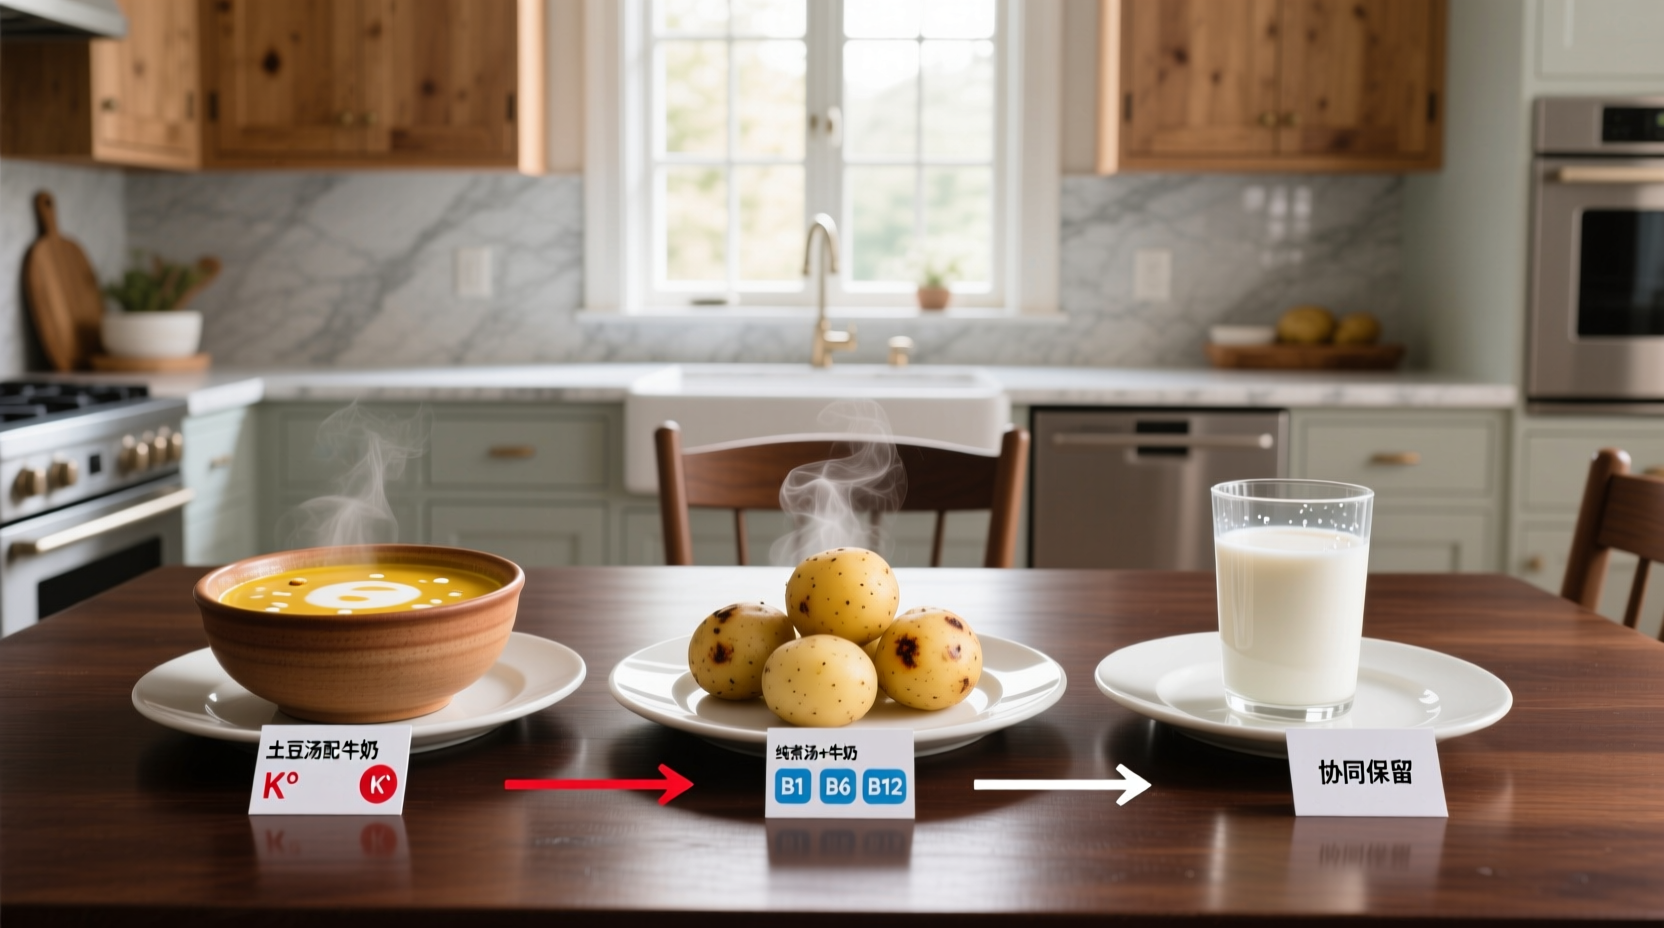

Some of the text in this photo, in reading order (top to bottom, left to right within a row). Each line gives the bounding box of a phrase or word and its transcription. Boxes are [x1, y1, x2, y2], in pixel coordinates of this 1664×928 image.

[266, 739, 379, 760] 土豆汤配牛奶
[1318, 759, 1412, 785] 协同保留
[781, 777, 903, 796] B1 B6 B12
